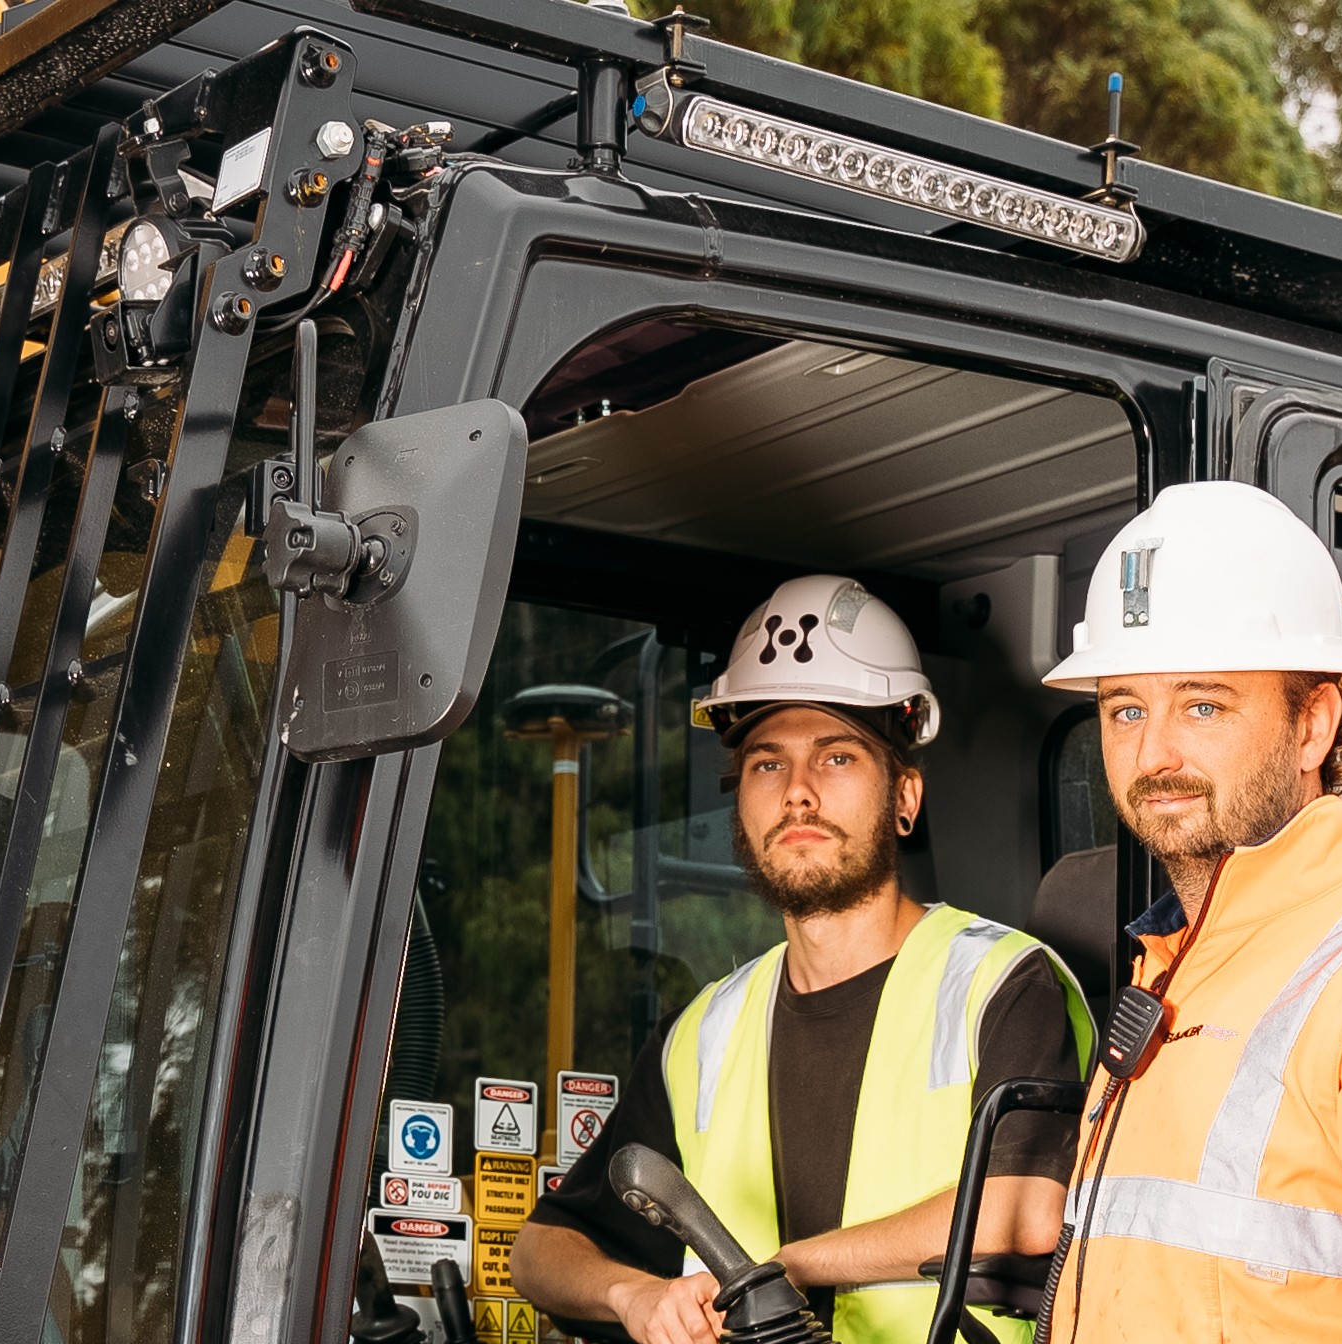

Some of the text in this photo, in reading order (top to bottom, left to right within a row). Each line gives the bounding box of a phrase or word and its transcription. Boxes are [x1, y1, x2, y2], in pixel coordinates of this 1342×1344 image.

[568, 1079, 607, 1092] DANGER
[490, 1089, 524, 1099] DANGER
[492, 1160, 530, 1173] WARNING
[481, 1174, 530, 1186] OPERATOR ONLY
[427, 1182, 451, 1190] BEFORE
[411, 1189, 450, 1201] YOU DIG
[486, 1189, 525, 1201] STRICTLY NO
[485, 1204, 525, 1215] PASSENGERS
[399, 1221, 442, 1233] DANGER
[480, 1231, 501, 1242] ROPS
[385, 1247, 416, 1255] instructions
[489, 1247, 501, 1257] DO
[482, 1261, 500, 1273] CUT,
[485, 1276, 497, 1286] OR
